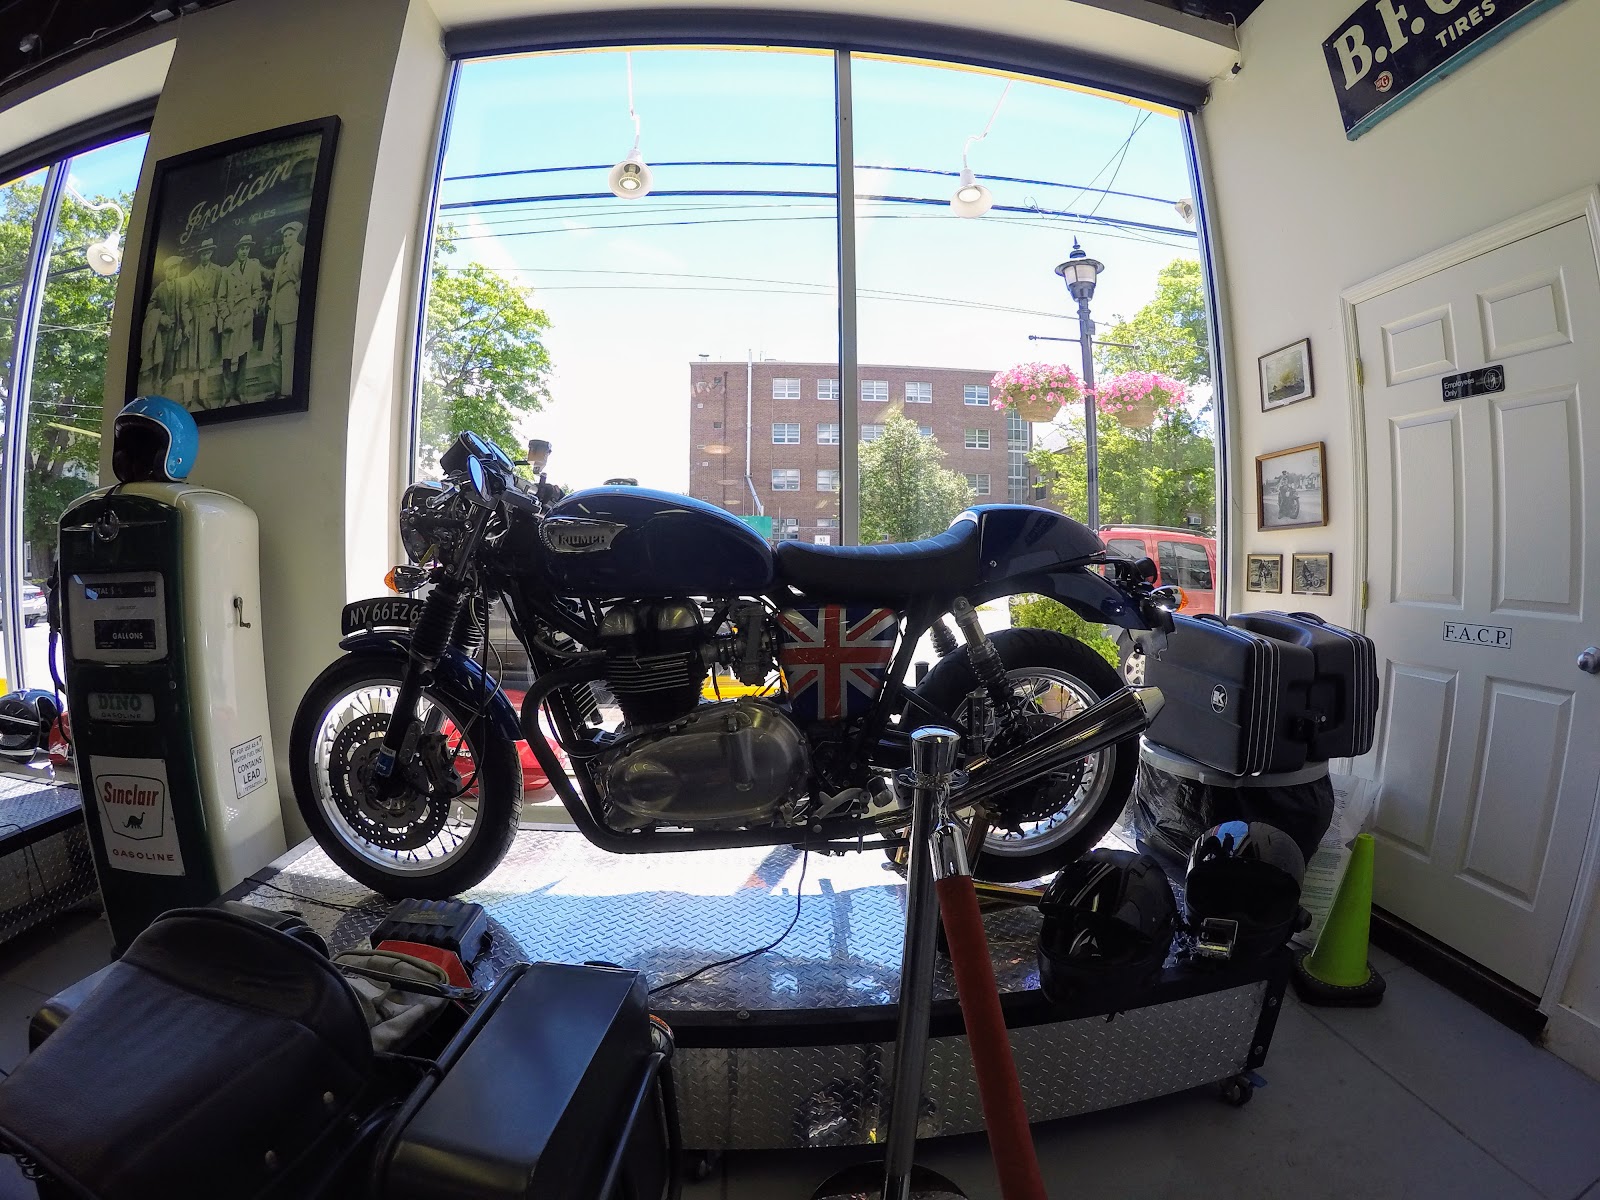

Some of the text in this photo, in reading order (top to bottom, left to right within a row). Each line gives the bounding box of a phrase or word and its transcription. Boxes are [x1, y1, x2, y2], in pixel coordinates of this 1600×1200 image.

[1435, 0, 1496, 48] TIRES
[179, 157, 302, 245] Indian
[1443, 378, 1475, 390] Employees
[1444, 390, 1458, 398] Only
[349, 602, 419, 627] NY 66EZ6
[112, 632, 144, 640] GALLONS
[1445, 624, 1509, 646] F.A.C.P.
[97, 694, 142, 712] DINO
[238, 756, 262, 774] CONTAINS
[243, 768, 260, 784] LEAD
[104, 781, 159, 807] Sinclair
[112, 848, 175, 862] GASOLINE
